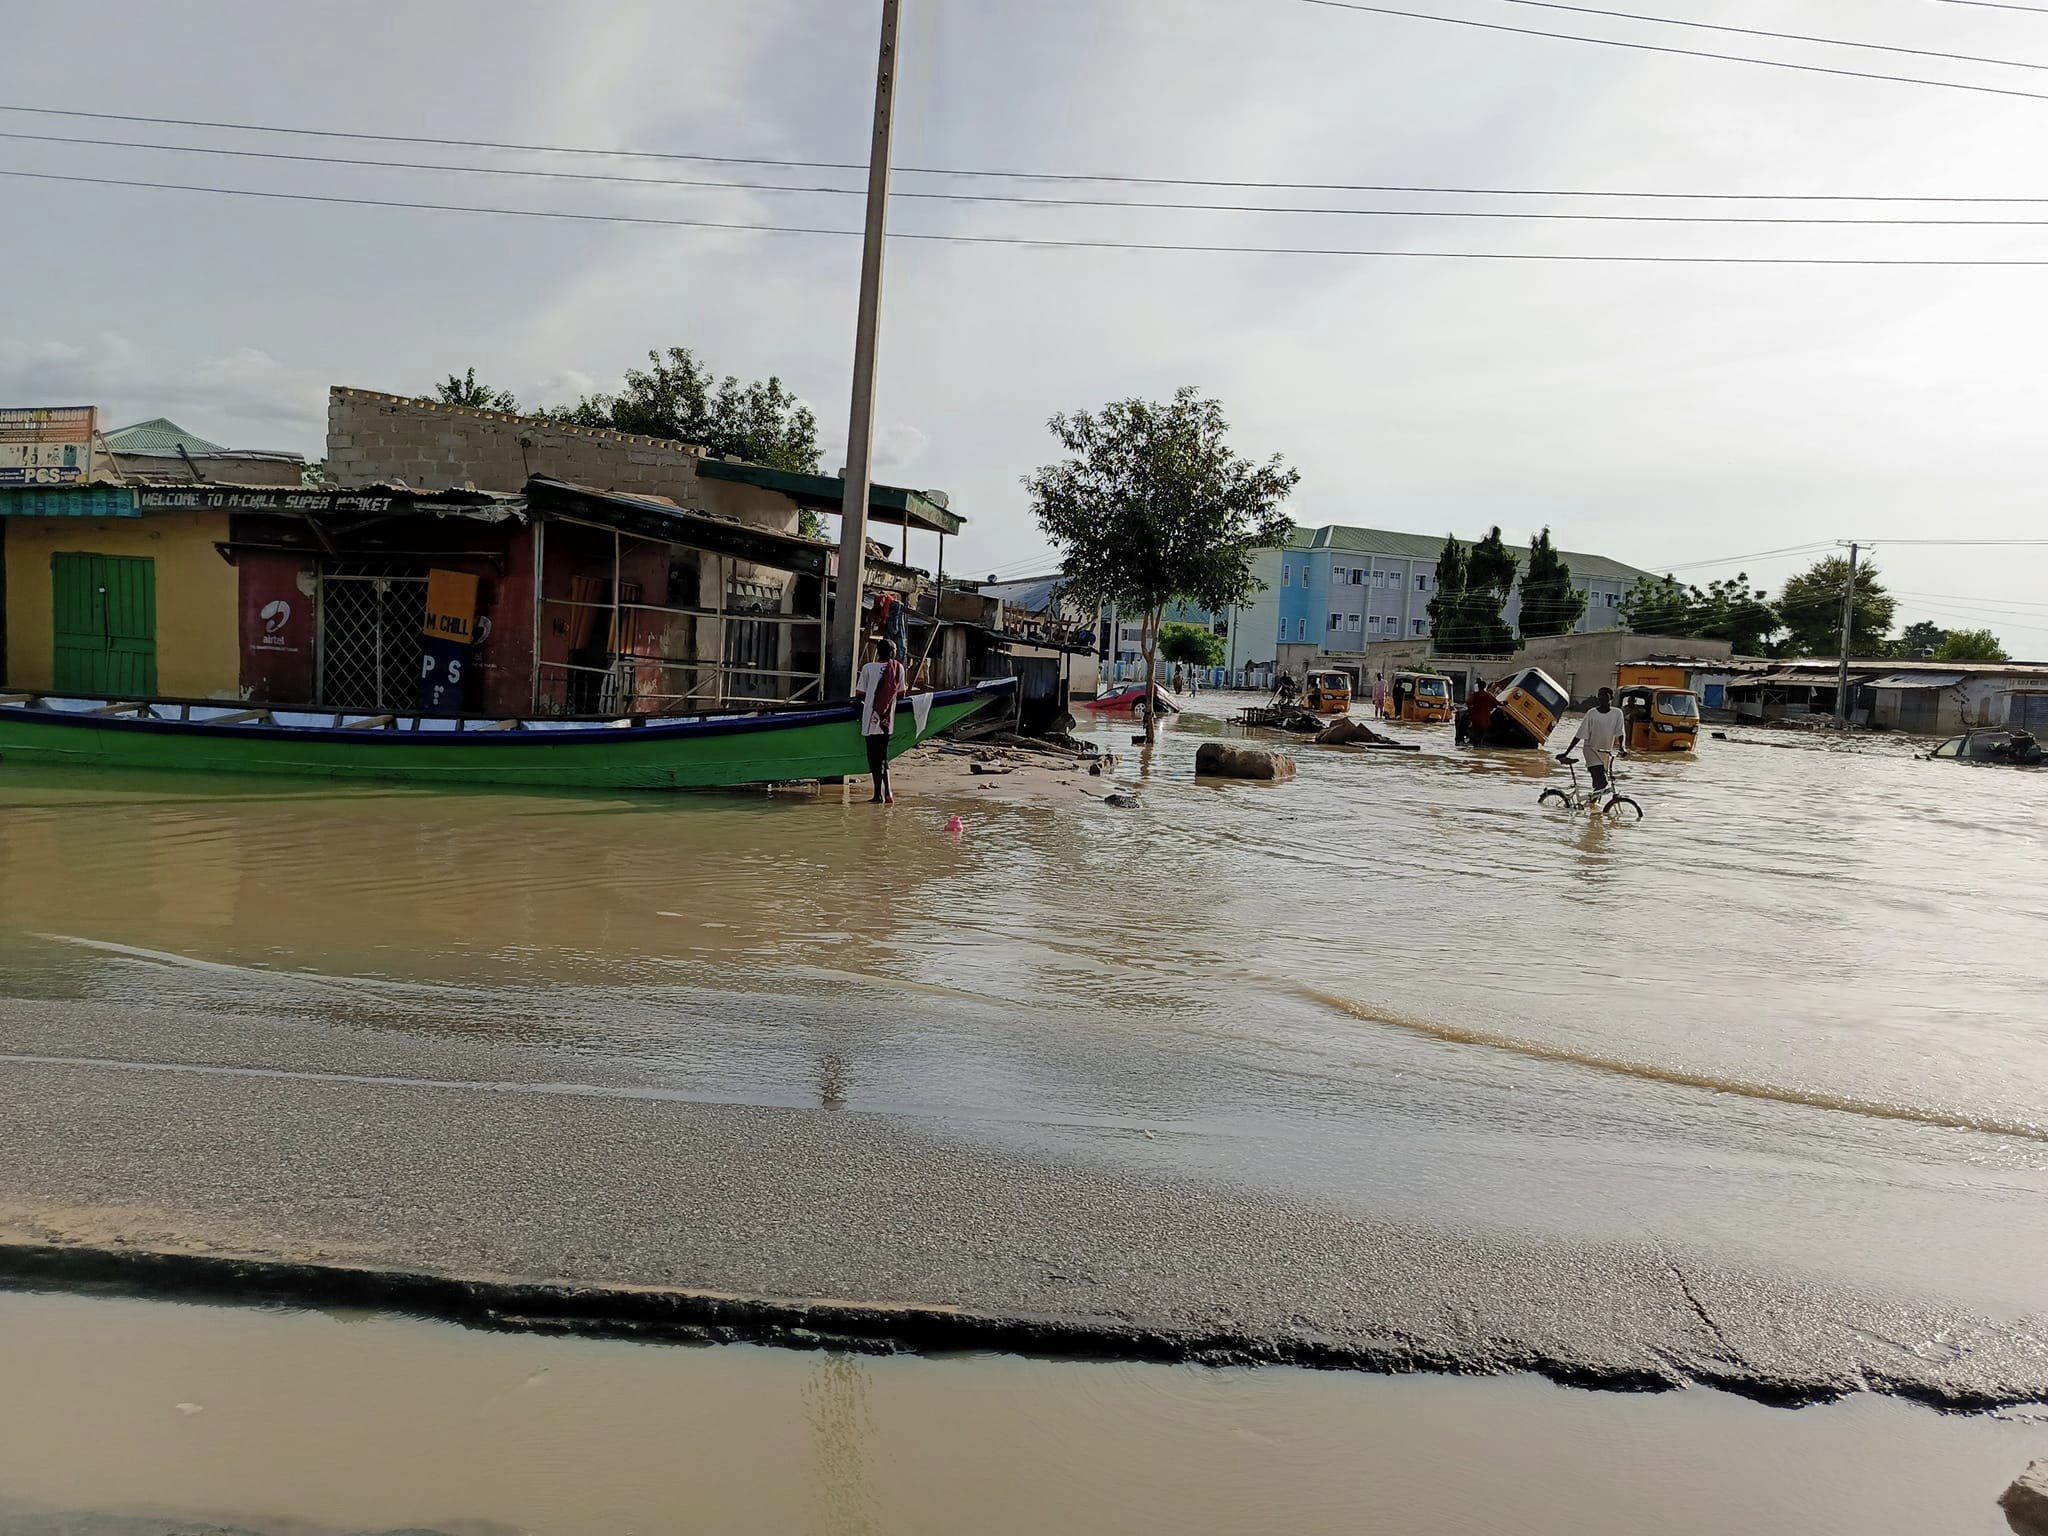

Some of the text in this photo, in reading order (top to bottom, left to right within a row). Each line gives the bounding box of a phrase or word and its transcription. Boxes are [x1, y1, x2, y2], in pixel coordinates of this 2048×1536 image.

[142, 493, 199, 506] WELCOME
[207, 493, 224, 507] TO
[284, 495, 331, 509] SUPER
[335, 497, 393, 511] MARKET
[262, 634, 286, 646] airtel
